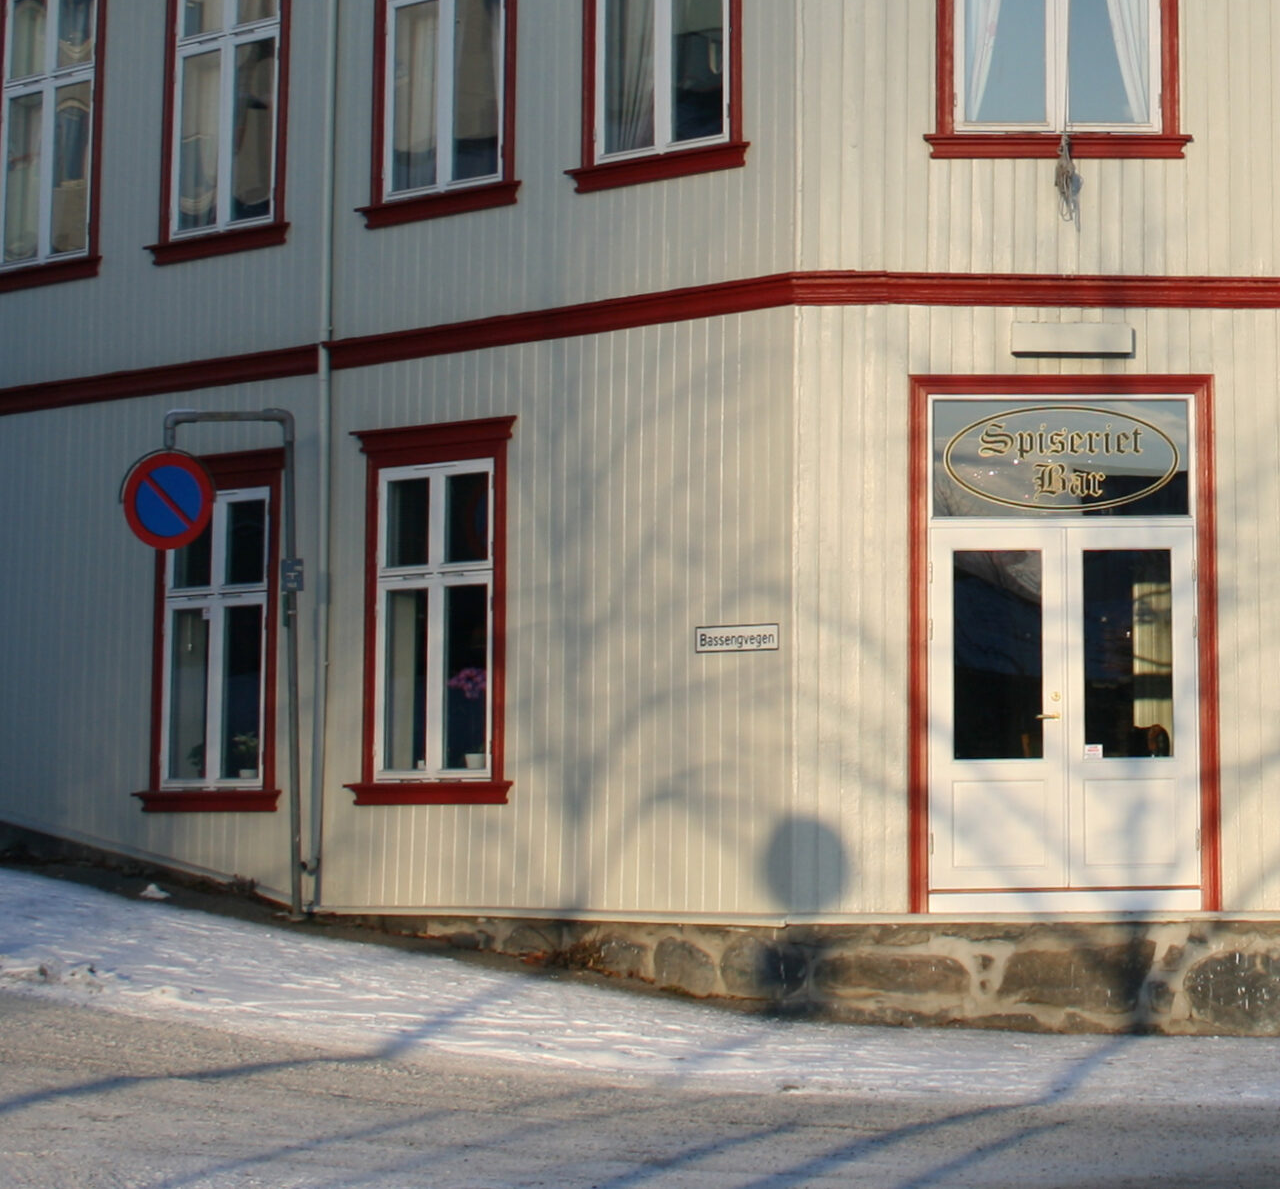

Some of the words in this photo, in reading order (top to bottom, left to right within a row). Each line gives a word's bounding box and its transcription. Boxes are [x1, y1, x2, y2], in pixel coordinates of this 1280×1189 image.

[977, 422, 1143, 459] Spiseriet
[1031, 463, 1106, 501] Bar
[699, 633, 775, 648] Bassengvegen
